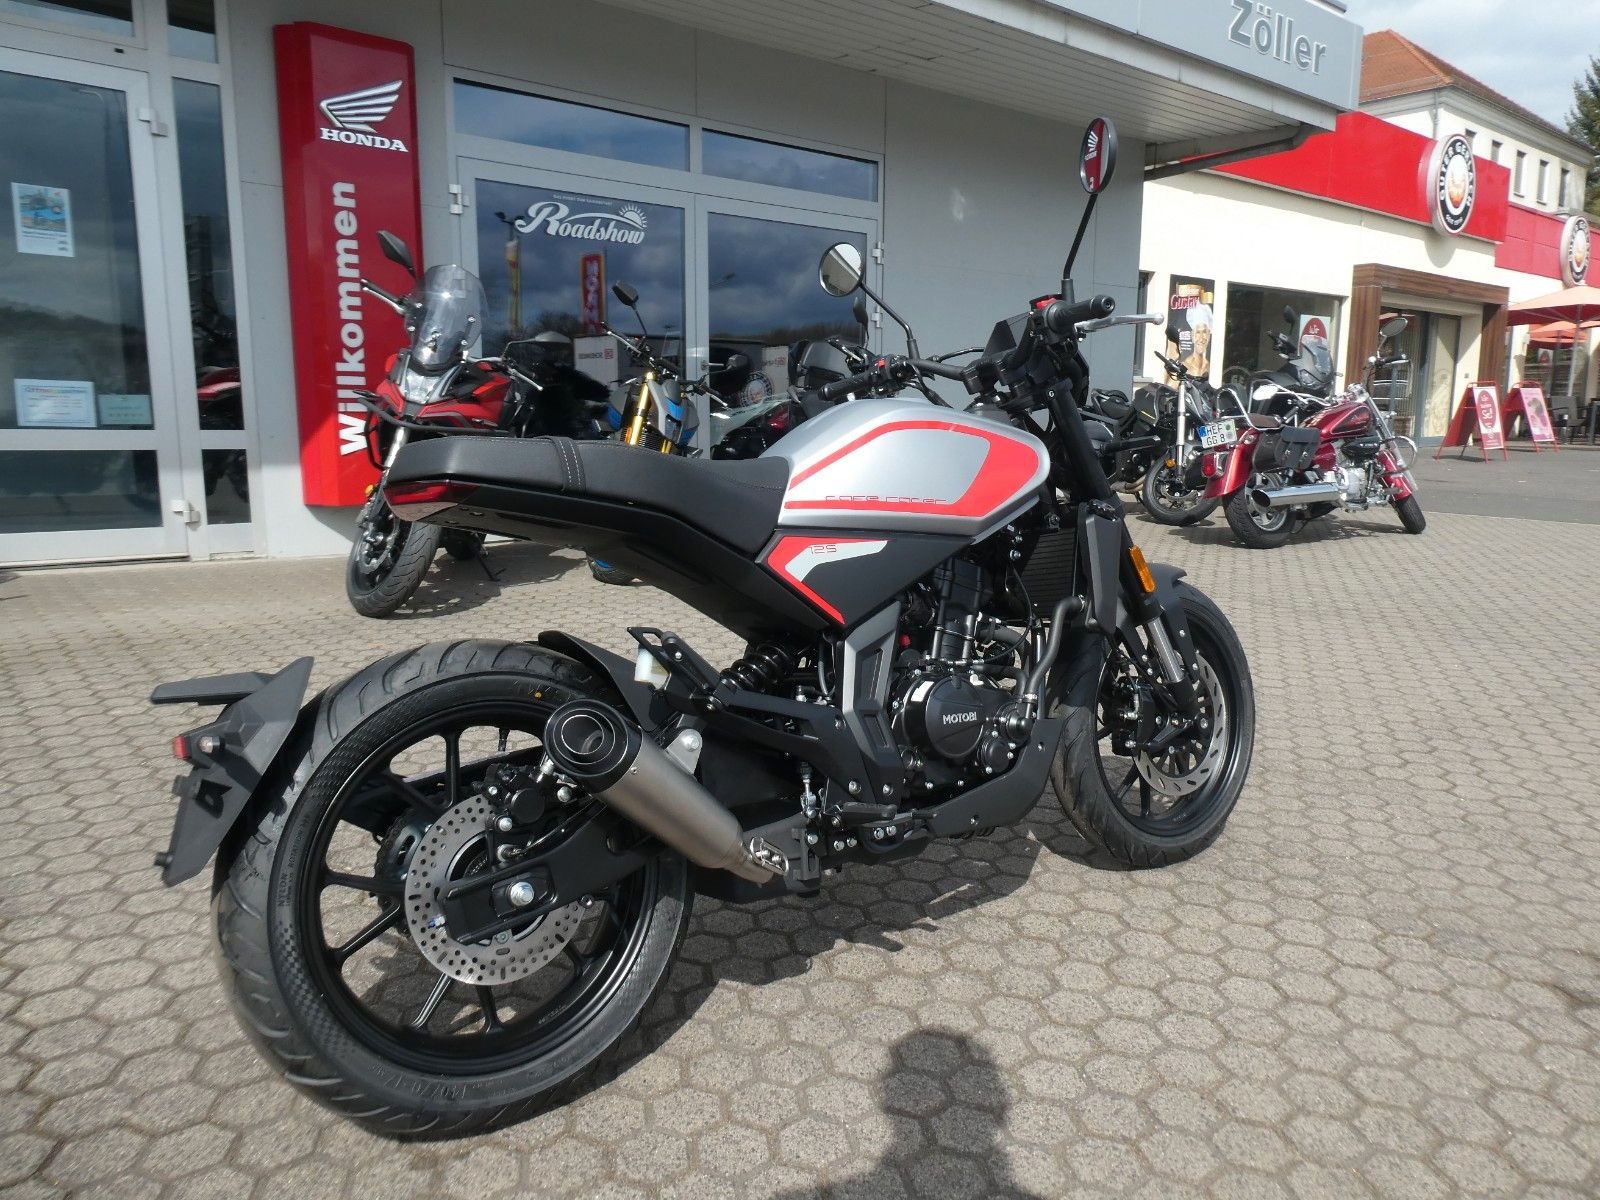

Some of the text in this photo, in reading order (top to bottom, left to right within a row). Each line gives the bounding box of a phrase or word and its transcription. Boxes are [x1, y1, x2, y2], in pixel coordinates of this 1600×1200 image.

[1228, 0, 1327, 75] Zöller
[319, 127, 409, 152] HONDA
[514, 201, 645, 244] Roadshow
[332, 182, 369, 456] Willkommen
[1206, 423, 1223, 436] HEF
[1206, 434, 1226, 446] GG 8
[808, 544, 837, 555] 125
[942, 711, 977, 725] MOTOBI
